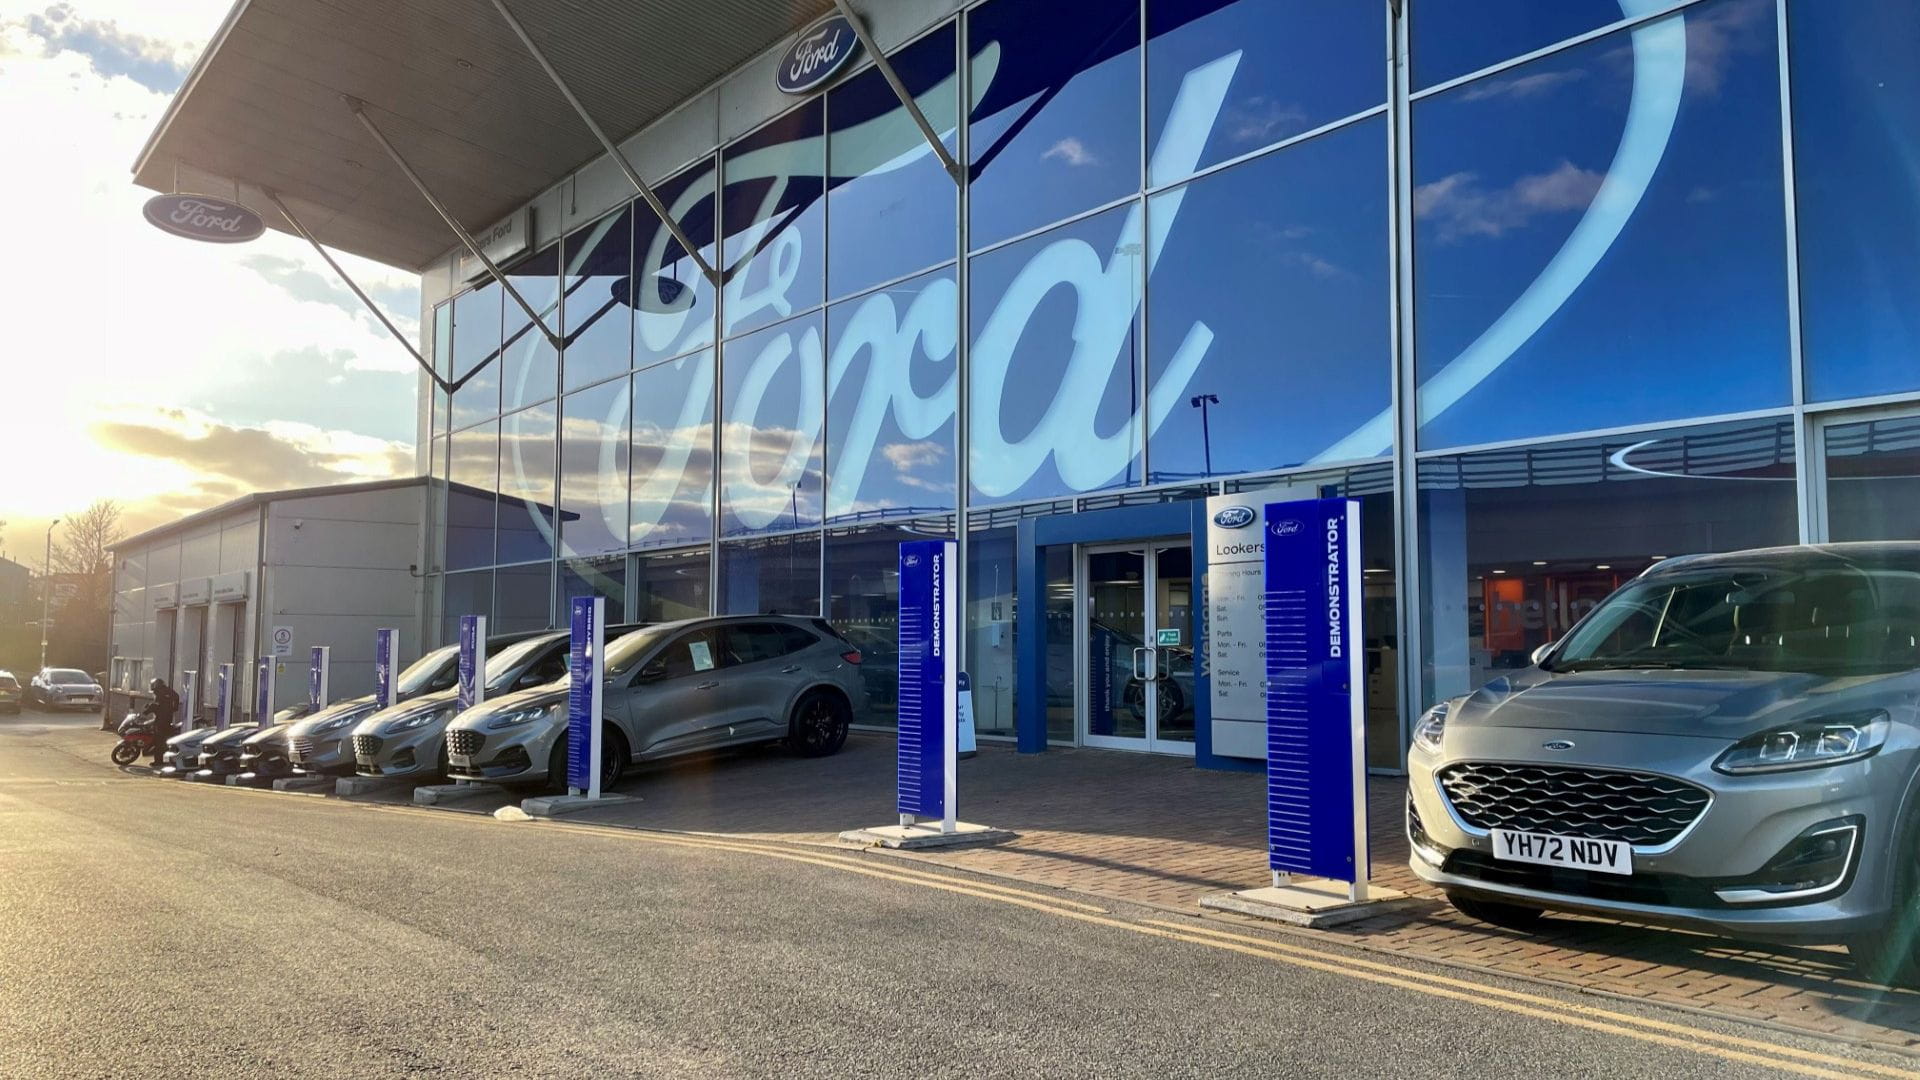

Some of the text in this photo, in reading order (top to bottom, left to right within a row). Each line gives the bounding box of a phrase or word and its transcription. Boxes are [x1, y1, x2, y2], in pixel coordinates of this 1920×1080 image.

[789, 28, 840, 82] Ford
[170, 199, 243, 232] Ford
[493, 218, 512, 241] Ford
[599, 39, 1244, 543] Ford
[1220, 509, 1245, 525] Ford
[1277, 521, 1299, 535] Ford
[1216, 542, 1264, 556] Lookers
[1242, 569, 1262, 577] Hours
[1327, 518, 1341, 658] DEMONSTRATOR
[1200, 572, 1210, 678] Welcome
[1503, 832, 1618, 867] YH72 NDV
